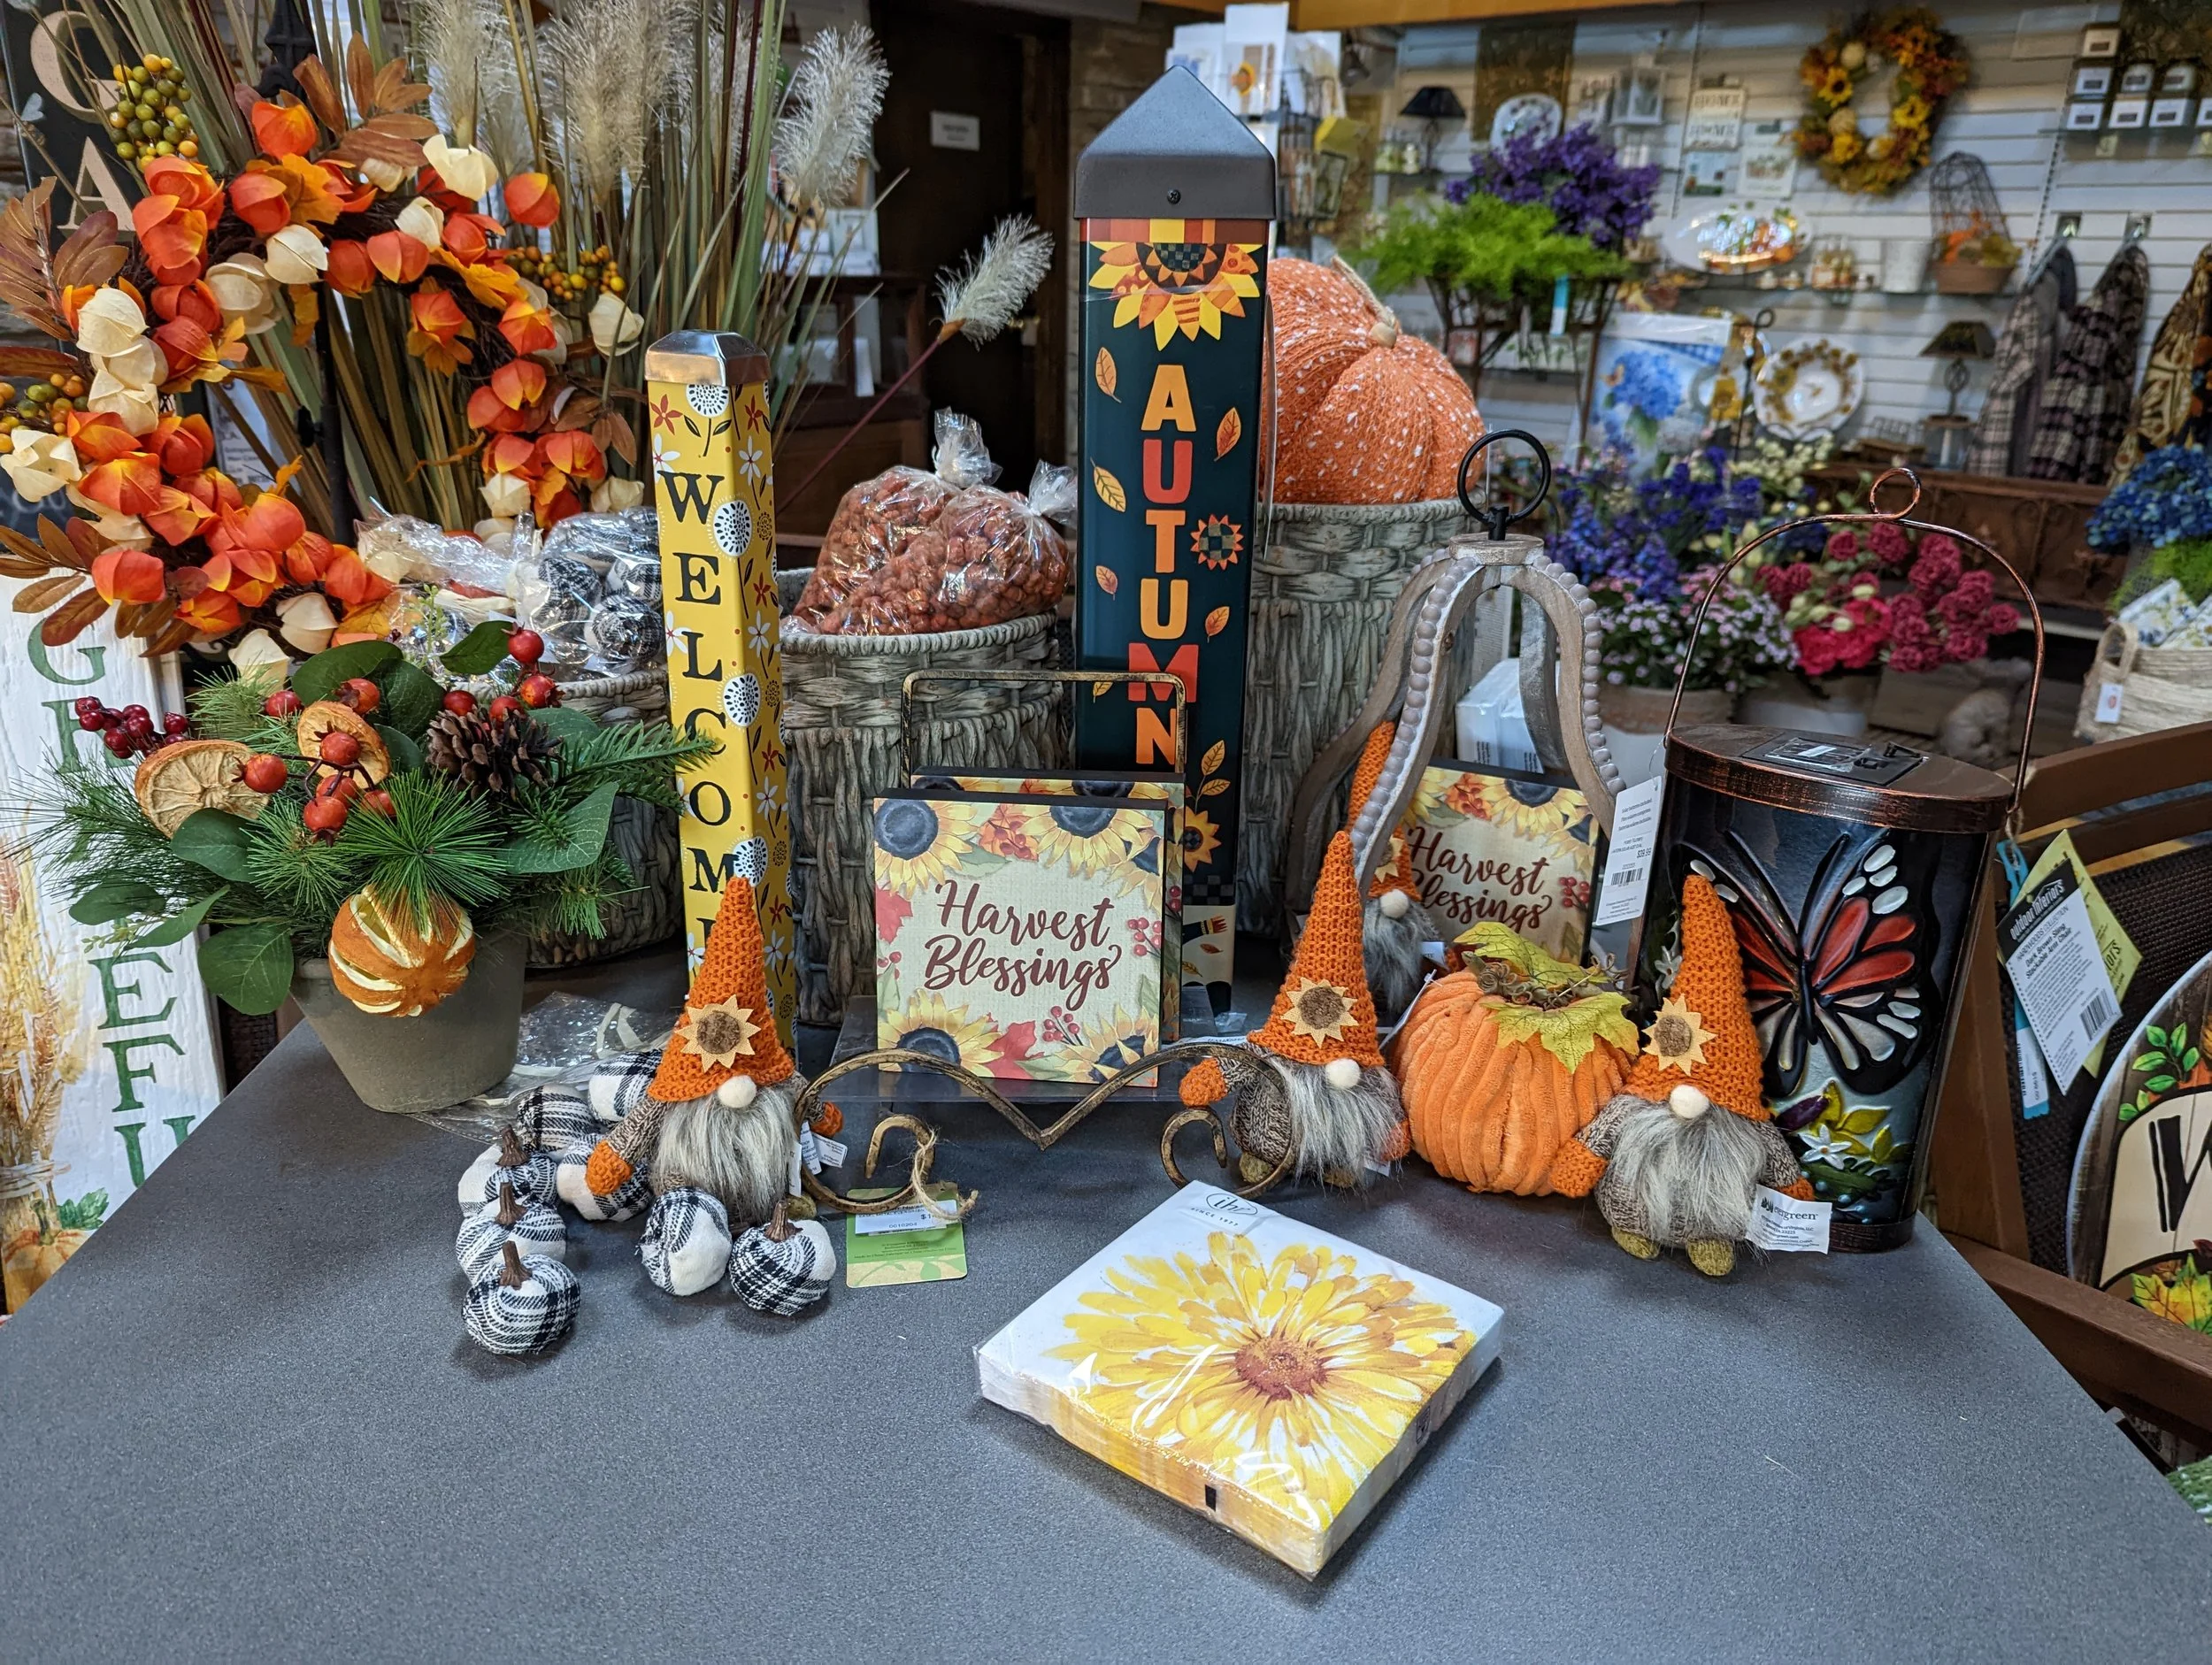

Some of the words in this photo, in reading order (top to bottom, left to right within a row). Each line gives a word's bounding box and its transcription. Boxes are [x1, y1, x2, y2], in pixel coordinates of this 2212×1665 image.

[1128, 364, 1199, 765] AUTUMN
[657, 469, 739, 947] WELCOM
[1408, 826, 1550, 895] Harvest
[935, 879, 1115, 952] Harvest
[1411, 868, 1553, 933] lessings
[2009, 908, 2035, 940] outdoor
[2032, 879, 2065, 916] interiors
[924, 934, 1122, 1011] Blessings
[2025, 951, 2038, 967] Dark
[2036, 936, 2053, 955] Brown
[2052, 923, 2067, 939] Sling
[2025, 952, 2048, 979] Stackable
[2047, 940, 2060, 953] Arm
[2058, 927, 2072, 943] Chair
[1191, 1207, 1216, 1218] SINCE
[1219, 1216, 1239, 1227] 1977
[1213, 1196, 1251, 1212] ihr
